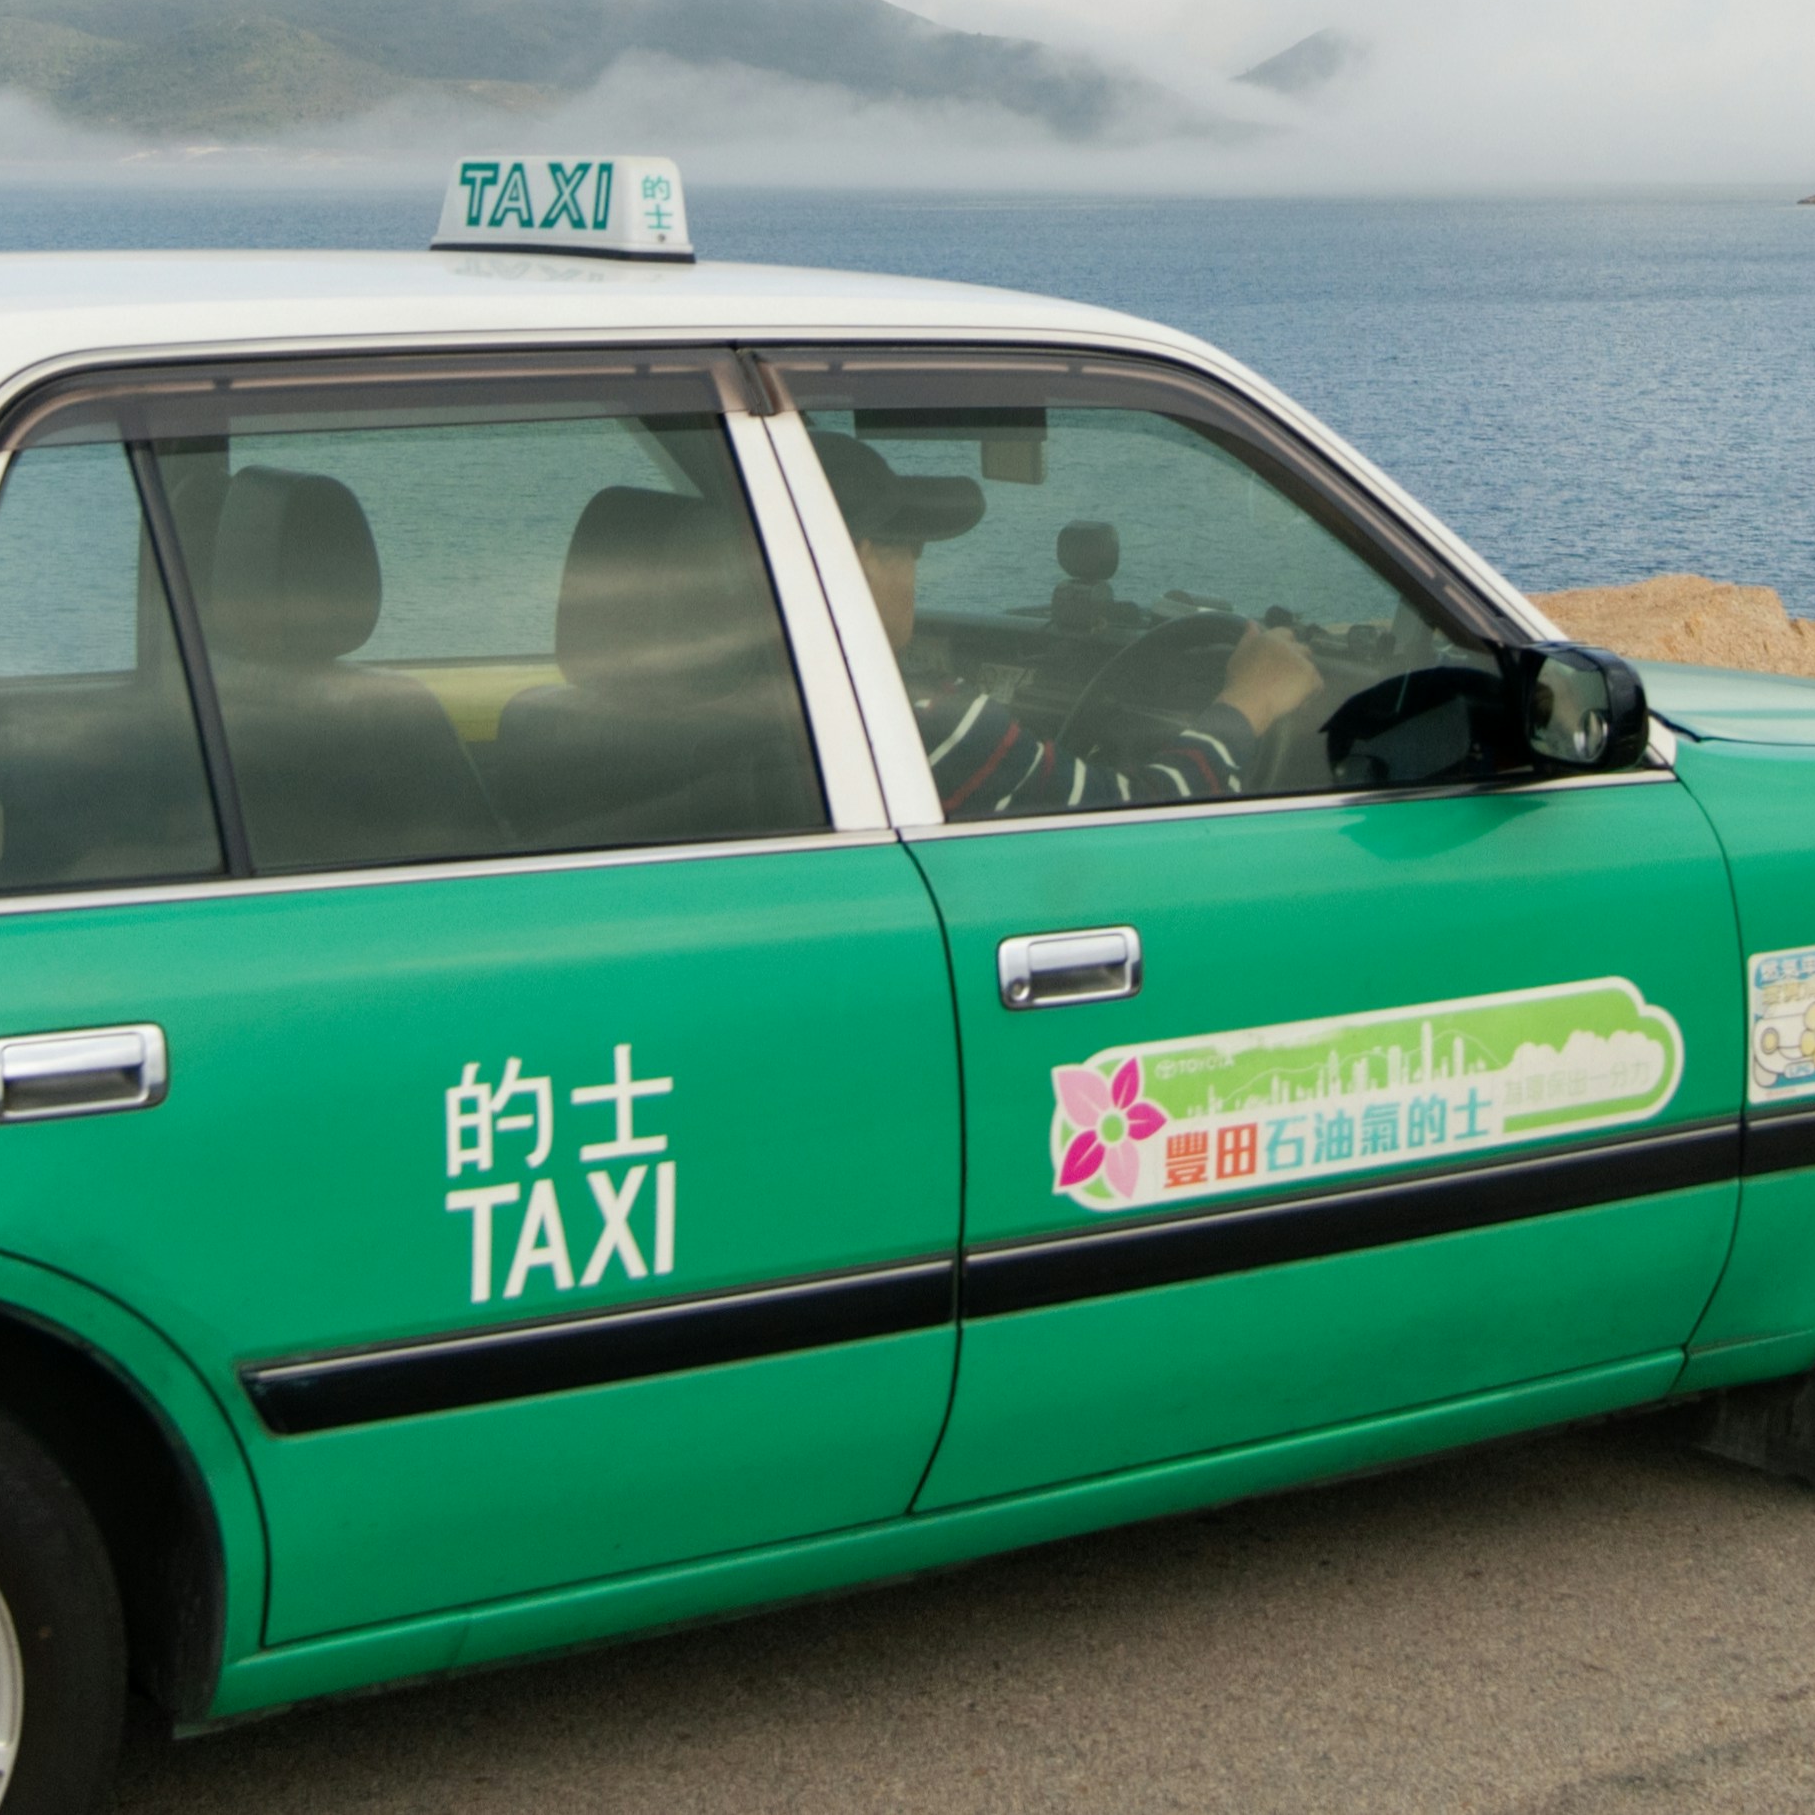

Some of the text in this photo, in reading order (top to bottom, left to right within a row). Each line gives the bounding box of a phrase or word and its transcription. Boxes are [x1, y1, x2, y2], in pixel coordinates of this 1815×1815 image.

[459, 162, 613, 230] TAXI
[641, 175, 673, 230] 的士
[1178, 1055, 1234, 1074] TOYOTA
[445, 1043, 674, 1178] 的士
[1164, 1087, 1492, 1189] 豐田石油氣的士
[445, 1160, 676, 1303] TAXI
